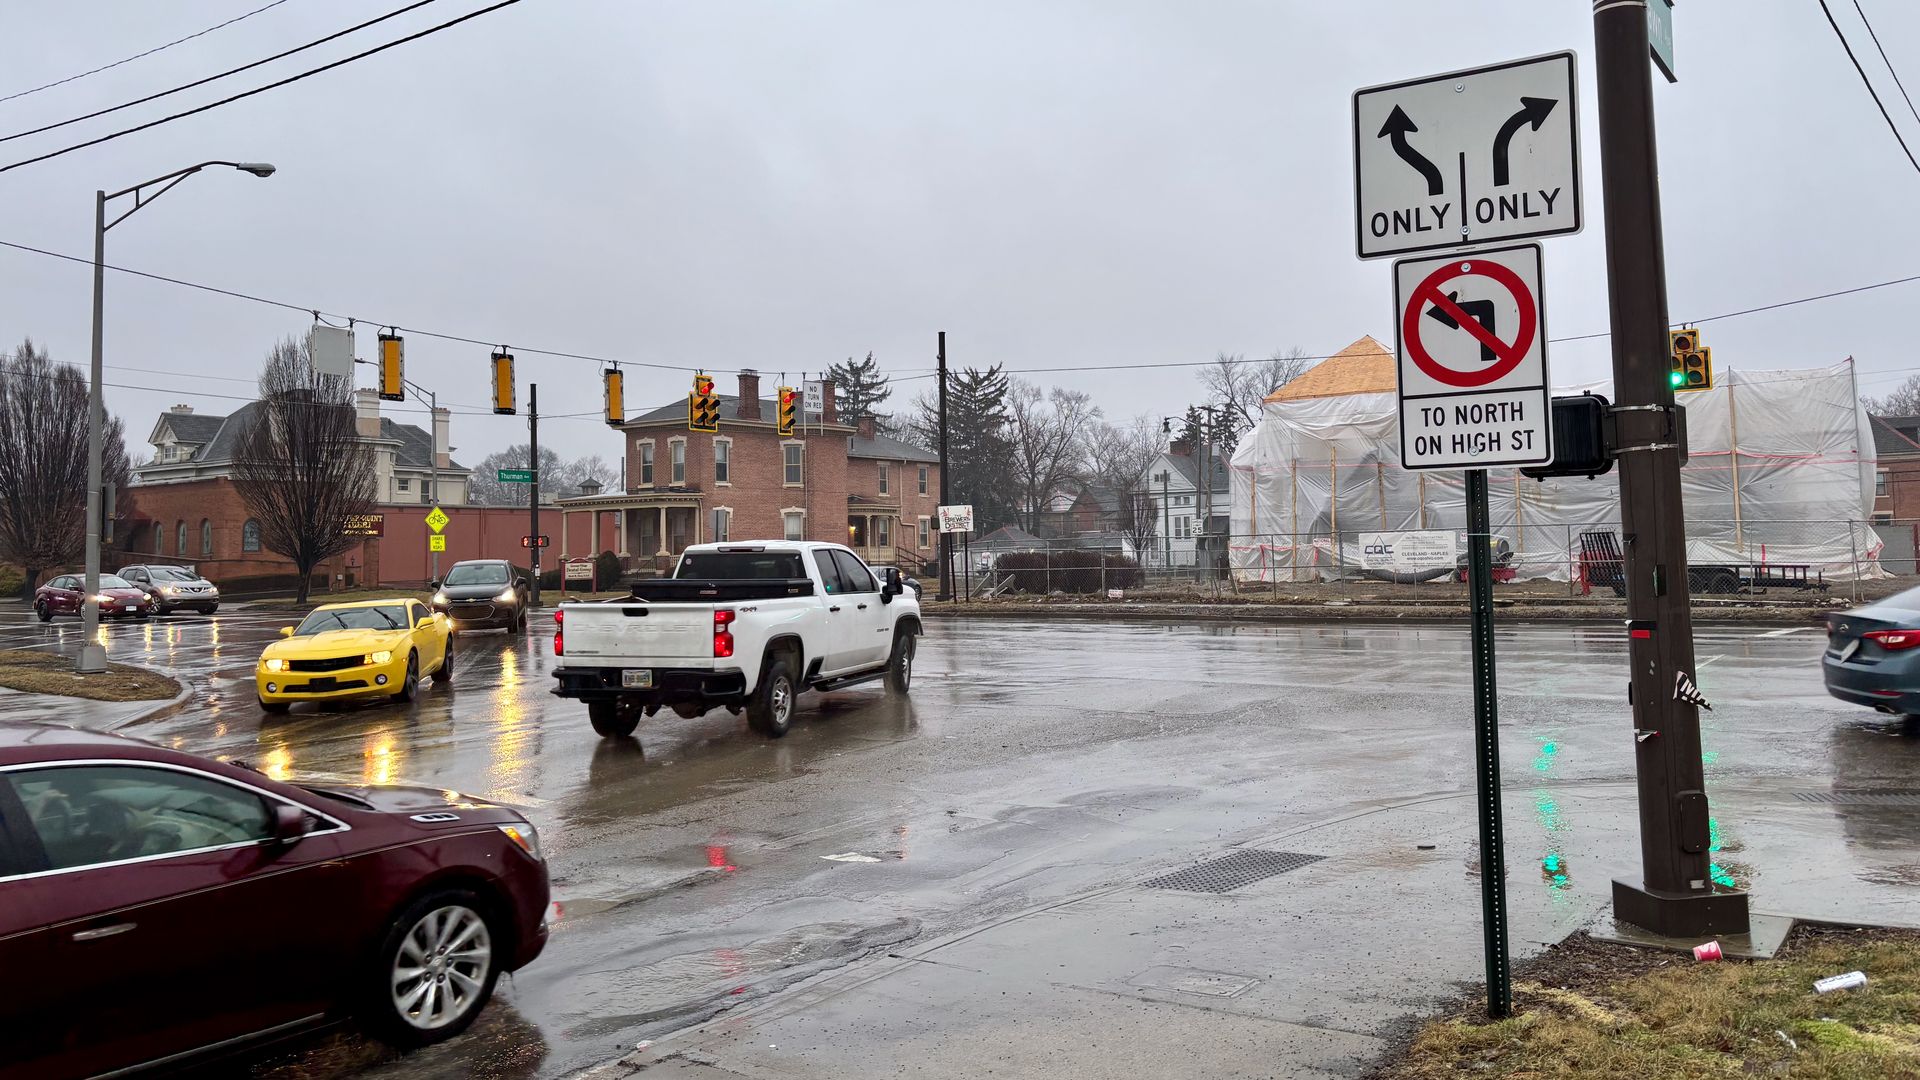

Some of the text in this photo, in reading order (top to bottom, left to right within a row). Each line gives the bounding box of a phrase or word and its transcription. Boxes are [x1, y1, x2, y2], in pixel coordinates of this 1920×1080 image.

[1371, 187, 1561, 238] ONLY ONLY
[807, 393, 820, 401] TURN
[1421, 401, 1524, 427] TO NORTH
[1415, 429, 1534, 456] ON HIGH ST
[1365, 545, 1394, 554] CQC
